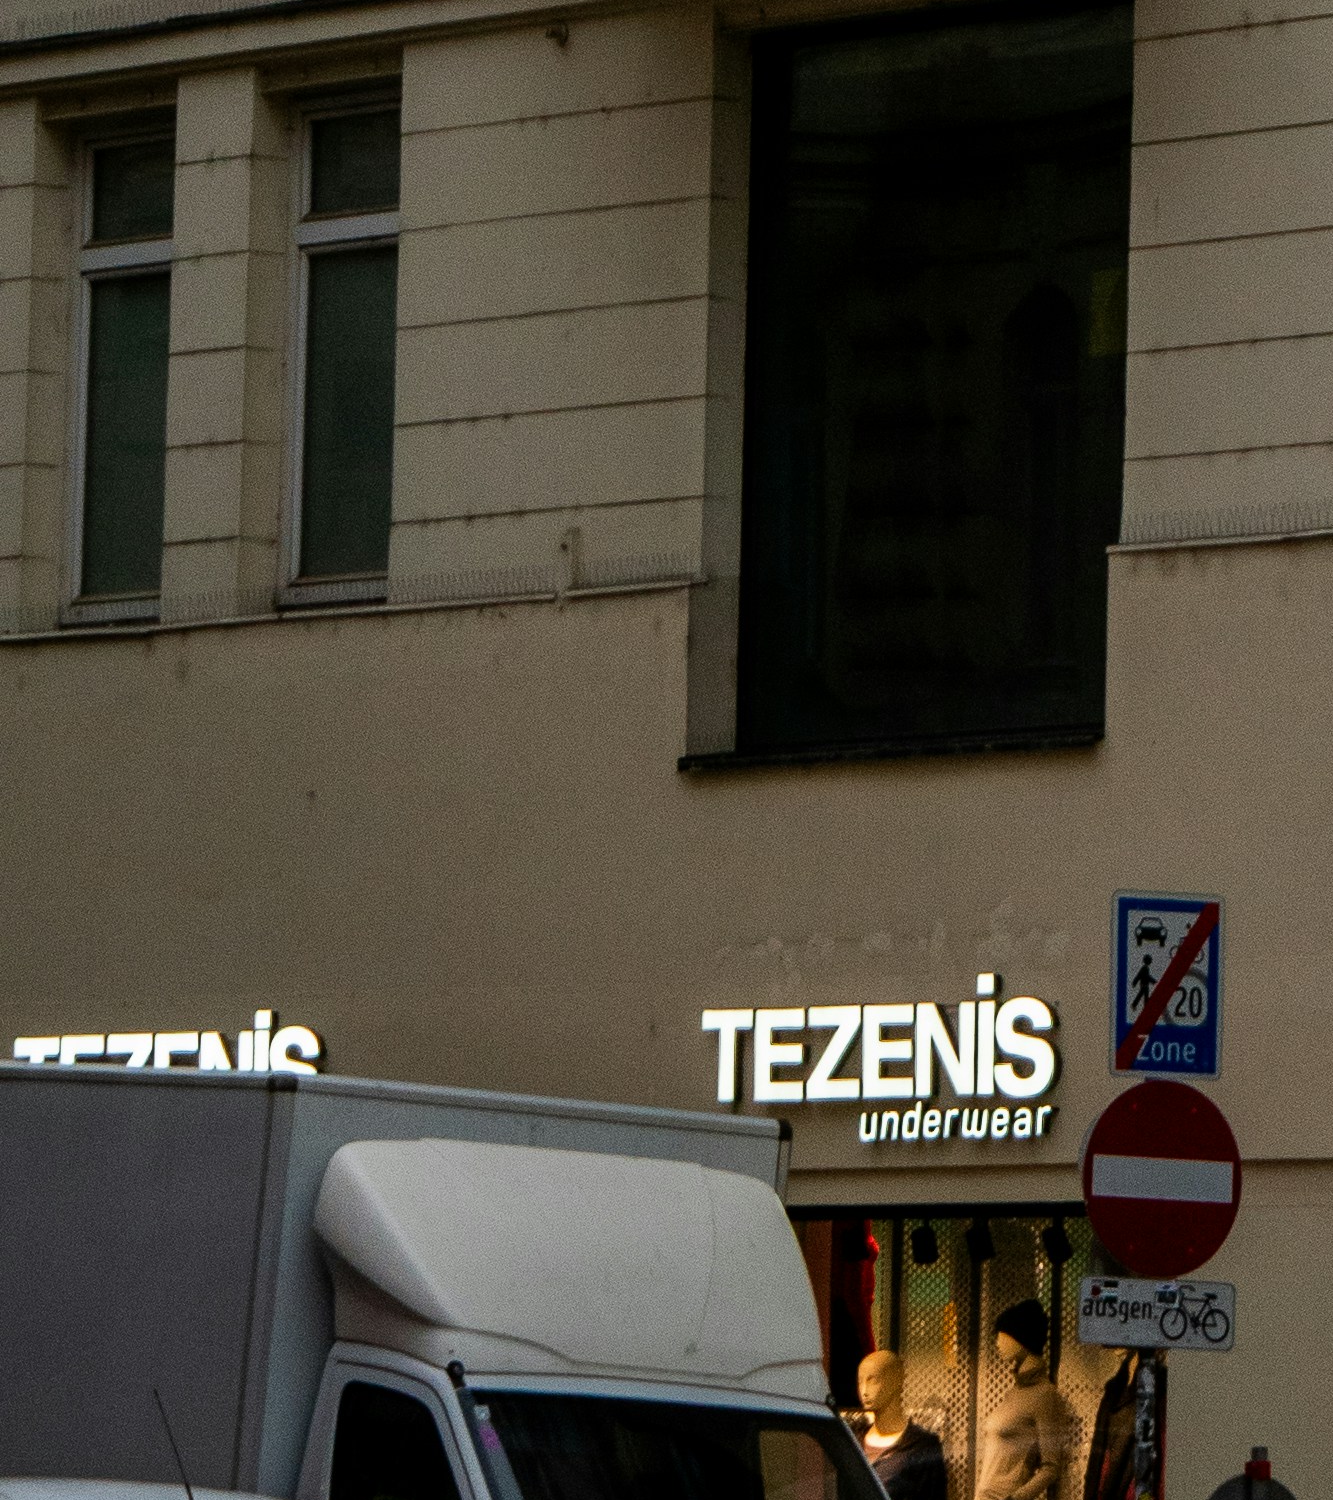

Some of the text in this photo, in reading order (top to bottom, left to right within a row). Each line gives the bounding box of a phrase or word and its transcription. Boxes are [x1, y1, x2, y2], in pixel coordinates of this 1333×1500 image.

[1175, 987, 1202, 1018] 20
[1136, 1033, 1197, 1063] Zone
[857, 1100, 1053, 1143] underwear
